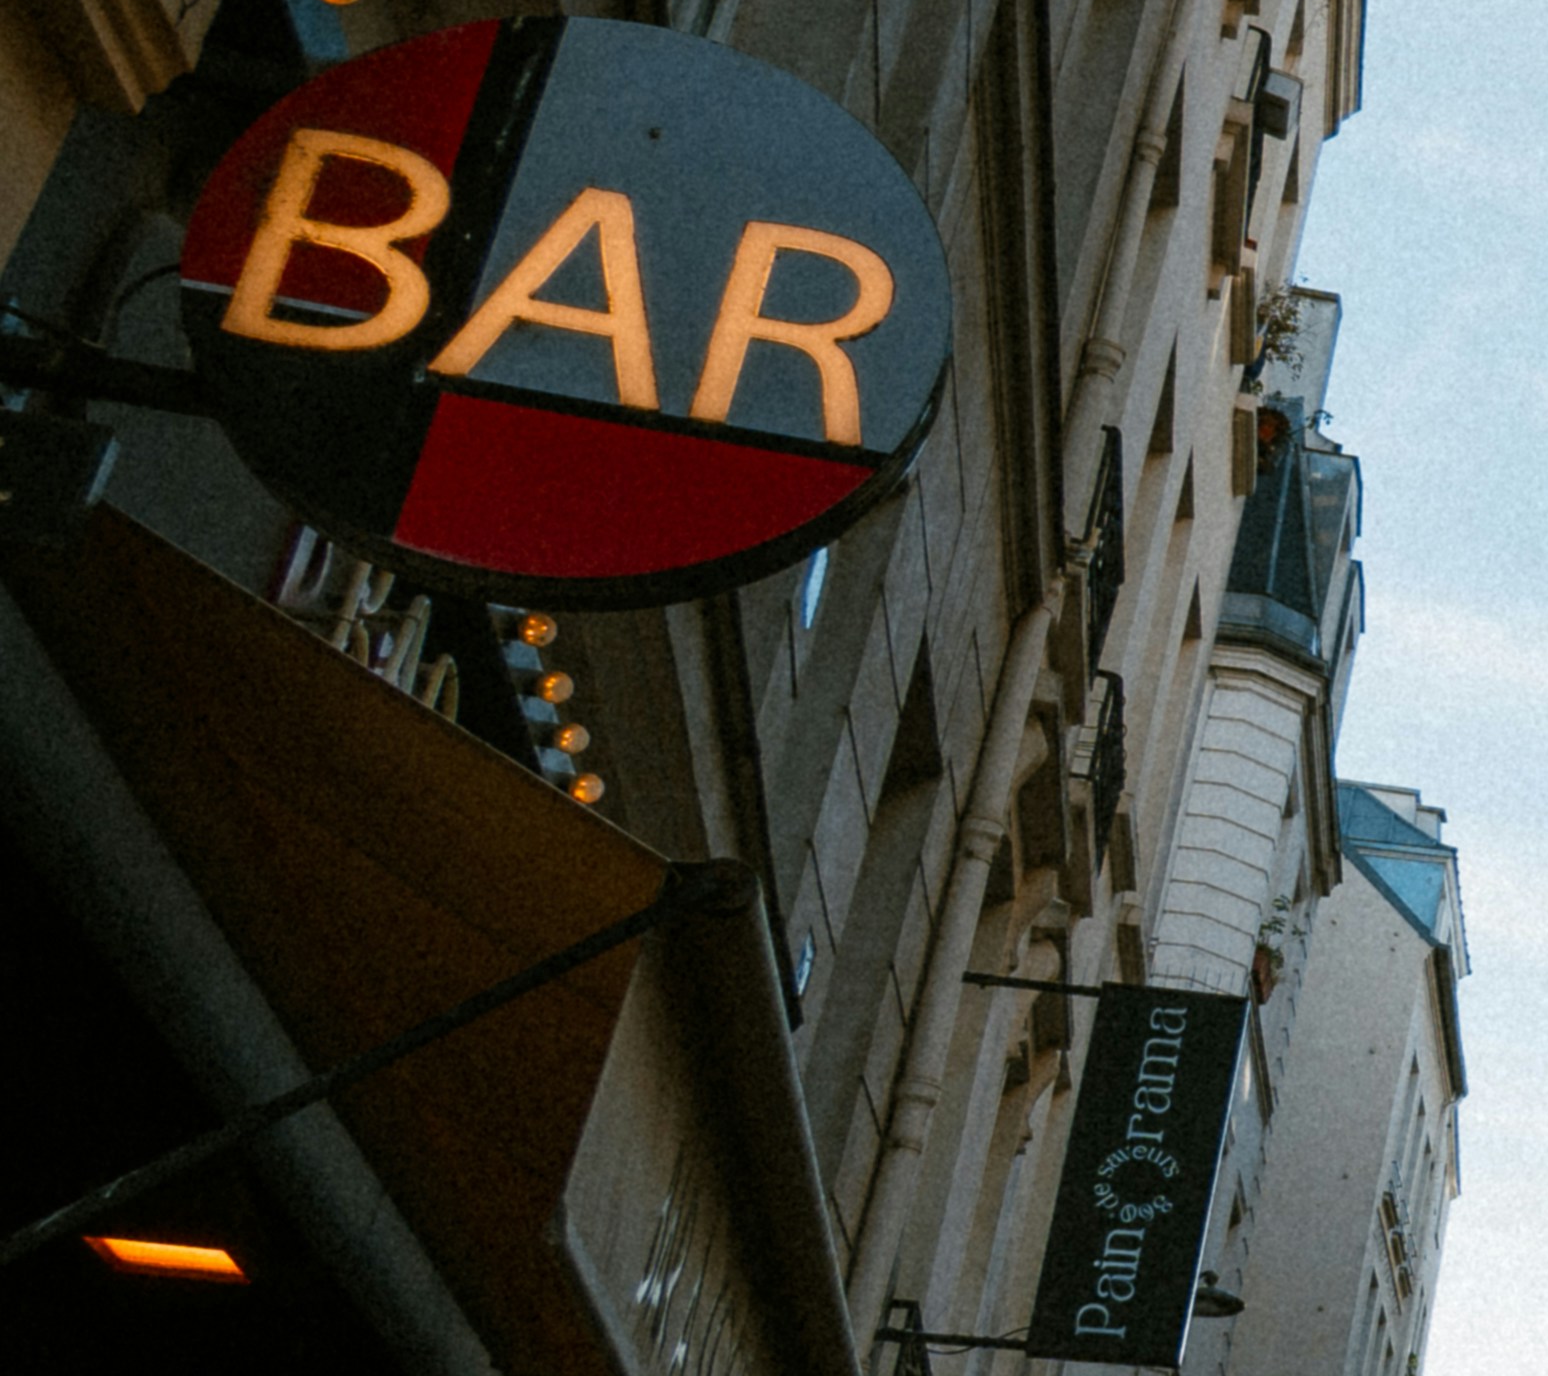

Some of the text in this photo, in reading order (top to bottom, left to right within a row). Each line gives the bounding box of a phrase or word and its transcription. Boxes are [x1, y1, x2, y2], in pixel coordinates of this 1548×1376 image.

[219, 126, 898, 448] BAR
[1097, 1143, 1181, 1179] saveurs
[1092, 1182, 1120, 1210] de
